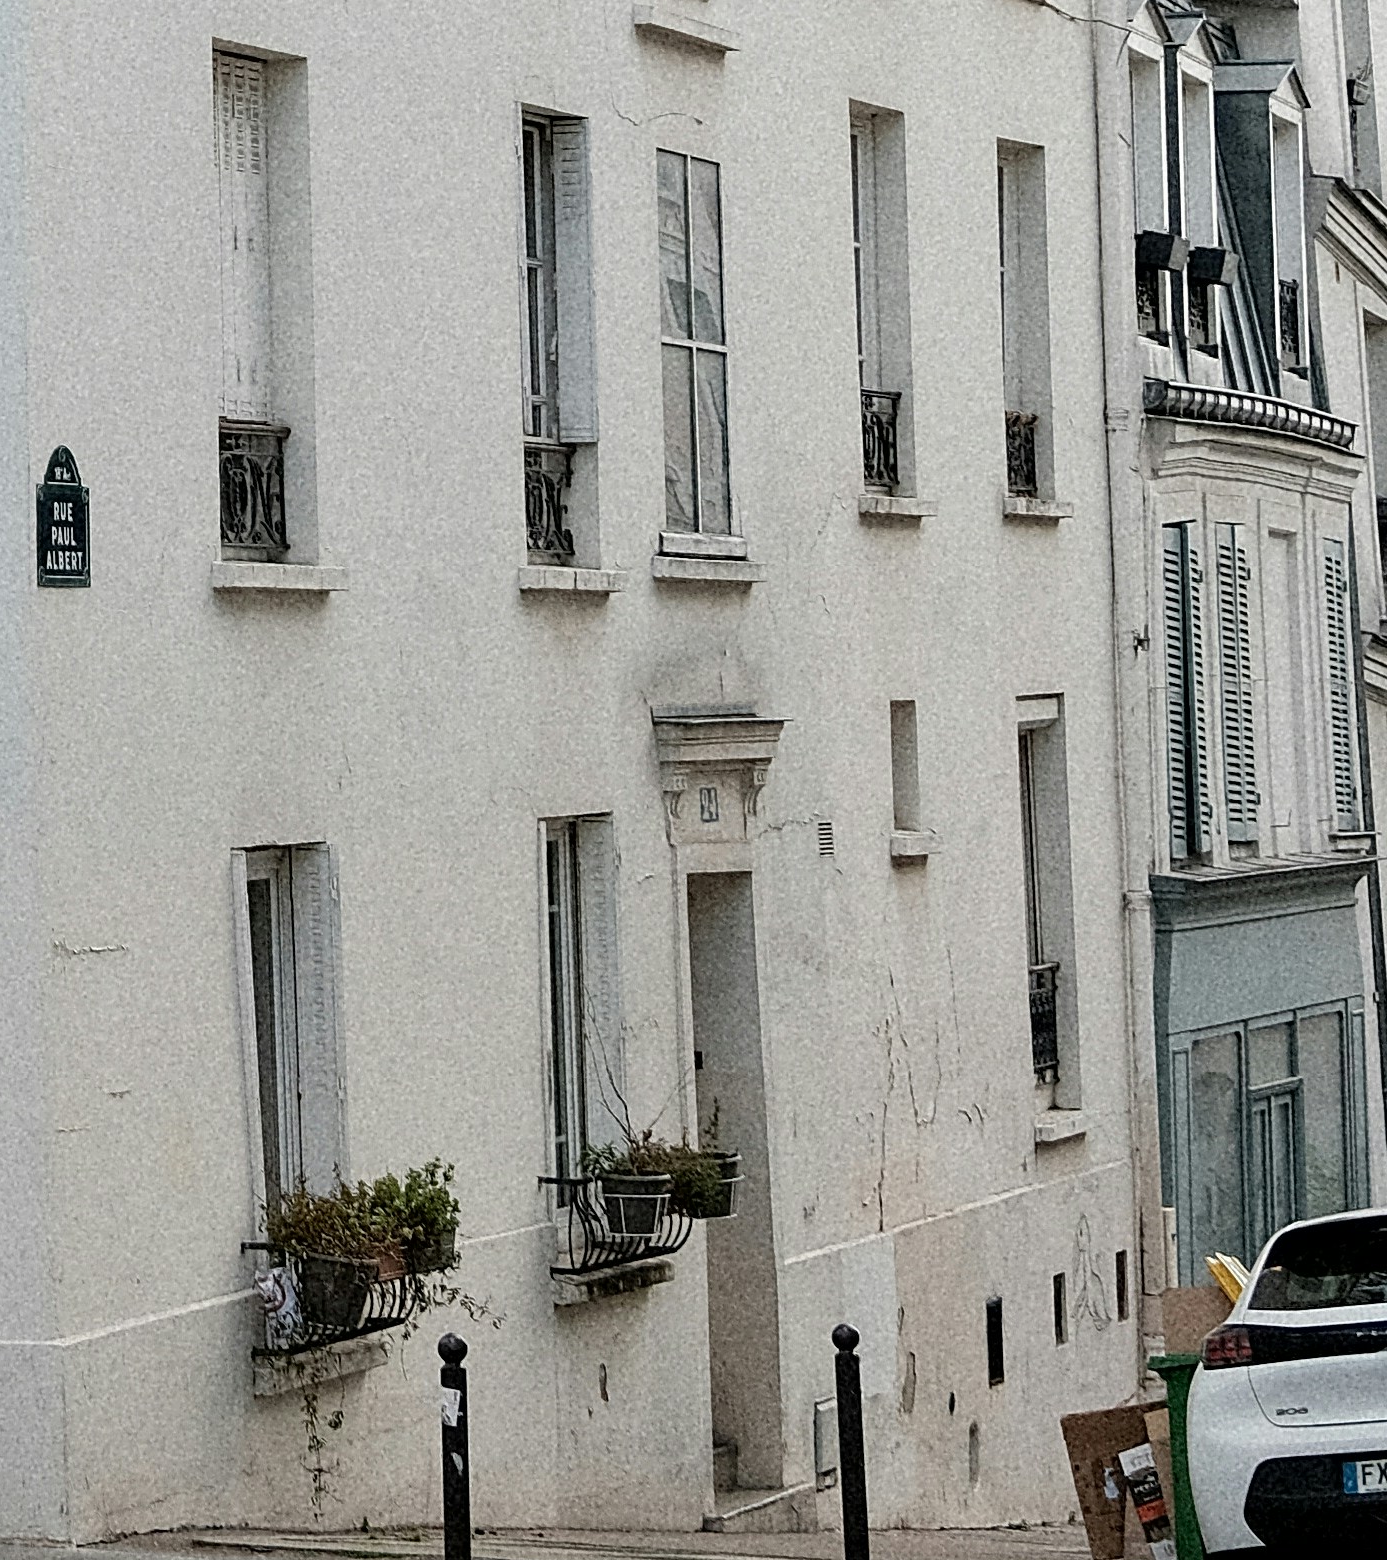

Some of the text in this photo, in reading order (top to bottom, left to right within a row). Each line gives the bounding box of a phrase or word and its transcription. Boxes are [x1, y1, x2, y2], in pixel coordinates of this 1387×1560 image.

[53, 501, 74, 522] RUE
[51, 526, 77, 546] PAUL
[46, 550, 83, 571] ALBERT
